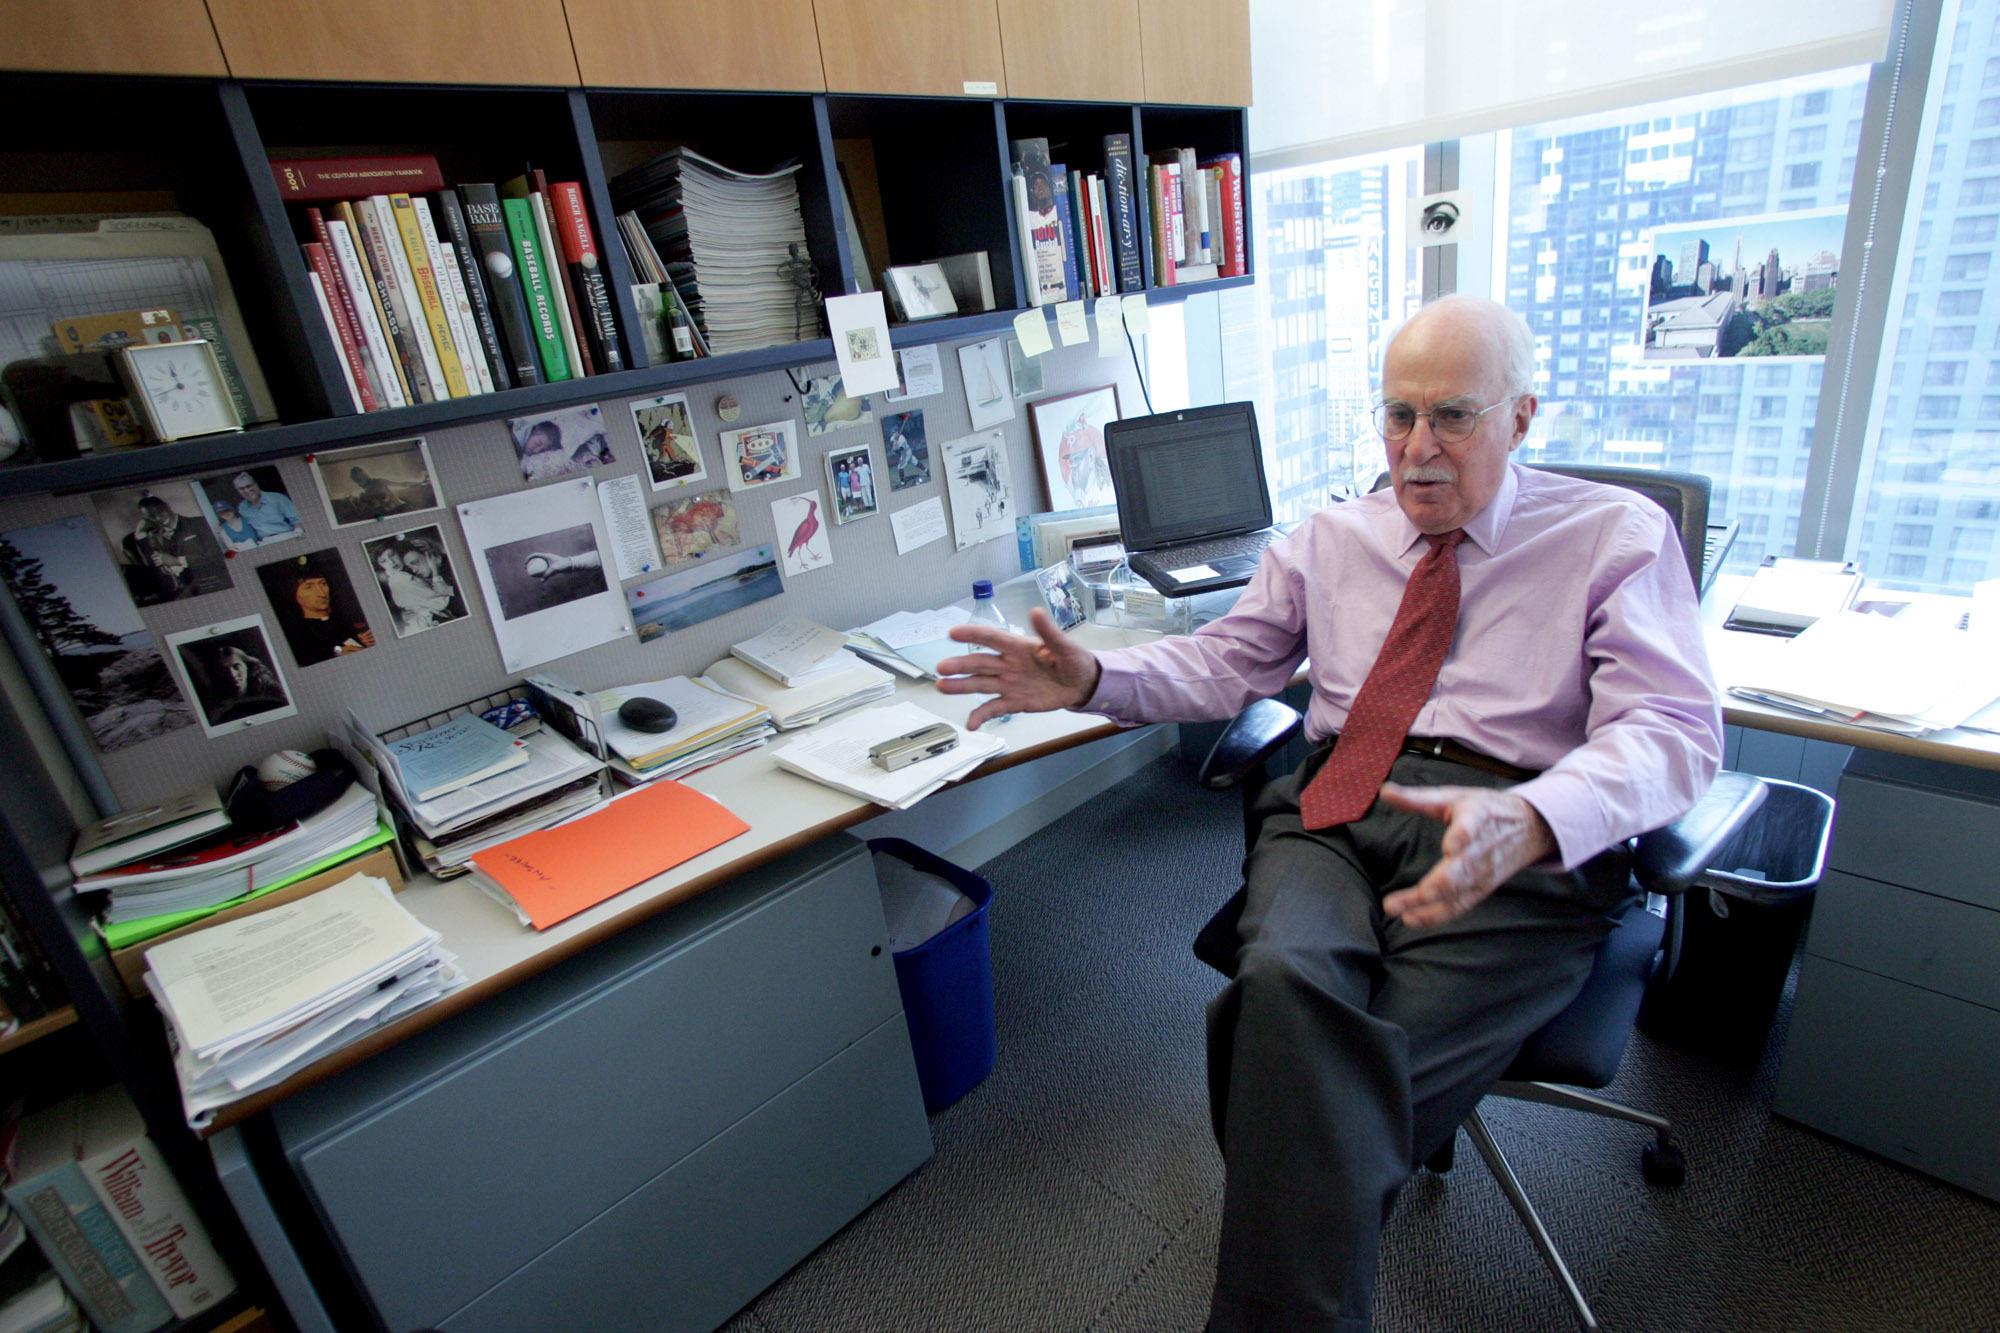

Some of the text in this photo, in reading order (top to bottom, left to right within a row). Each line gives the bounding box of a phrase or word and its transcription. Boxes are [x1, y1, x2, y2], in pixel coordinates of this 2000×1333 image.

[284, 167, 299, 192] 2001
[418, 207, 428, 221] It's
[423, 222, 432, 237] Not
[467, 203, 499, 214] BASE
[470, 213, 502, 224] BALL
[565, 187, 590, 249] ROGER ANGELL
[337, 229, 353, 257] Breaking
[370, 225, 382, 243] HERE
[379, 253, 390, 272] YOUR
[385, 274, 396, 289] WAR
[427, 239, 439, 259] Over
[376, 280, 399, 334] CHICAGO
[416, 266, 440, 309] BASEBALL
[443, 292, 454, 311] Over
[459, 246, 470, 264] MAY
[466, 268, 476, 285] THE
[472, 288, 483, 307] BEST
[480, 311, 491, 334] TEAM
[487, 336, 497, 354] WIN
[521, 240, 543, 290] BASEBALL
[535, 295, 555, 339] RECORDS
[588, 274, 617, 338] GAME TIME
[96, 1147, 147, 1221] William
[143, 1222, 199, 1290] Trevor
